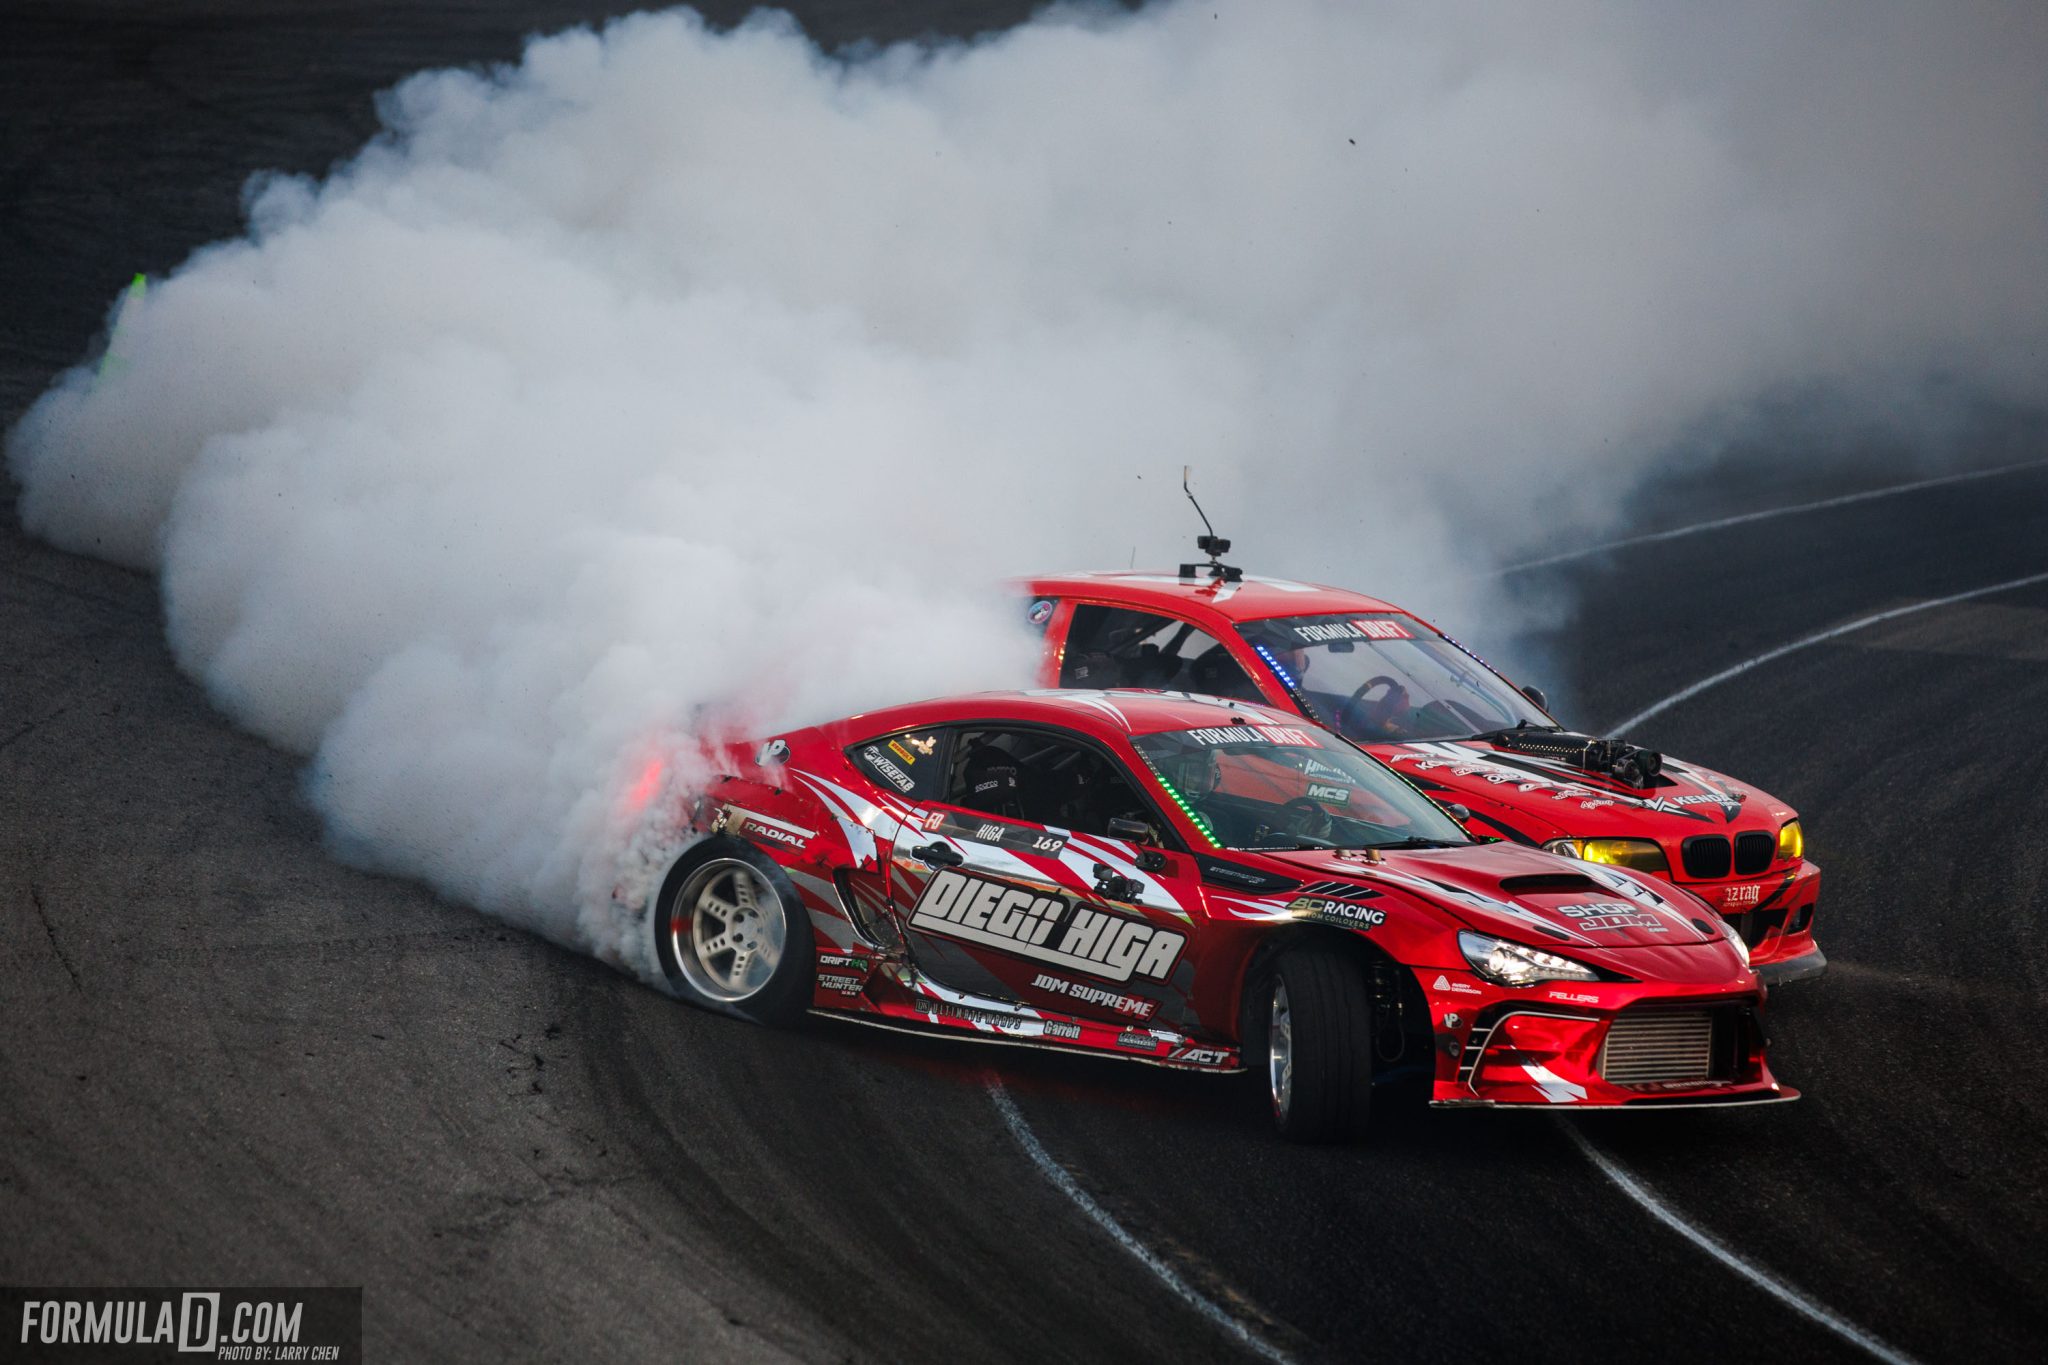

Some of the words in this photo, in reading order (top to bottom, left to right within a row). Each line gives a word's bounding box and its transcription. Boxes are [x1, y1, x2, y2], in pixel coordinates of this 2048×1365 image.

[1293, 623, 1367, 642] FORMULA
[1353, 620, 1410, 638] DRIFT
[1187, 727, 1270, 745] FORMULA
[1258, 726, 1317, 746] DRIFT
[873, 757, 914, 791] WISEFAB
[1308, 785, 1349, 800] MCS
[925, 812, 945, 830] FD
[744, 821, 806, 849] RADIAL
[975, 824, 1005, 843] HIGA
[1031, 836, 1063, 852] 169
[1323, 901, 1385, 925] RACING
[1557, 903, 1637, 917] SHOP
[917, 869, 1064, 945] DIEGO
[1058, 909, 1185, 980] HIGA
[1324, 914, 1370, 930] COILOVERS
[1579, 914, 1662, 931] JDM
[818, 974, 860, 984] STREET
[821, 981, 863, 992] HUNTER
[1031, 974, 1069, 994] JDM
[1069, 984, 1154, 1016] SUPREME
[1549, 991, 1599, 1003] FELLERS
[932, 1004, 982, 1023] ULTIMATE
[985, 1013, 1022, 1030] WRAPS
[1044, 1020, 1081, 1039] Garrett
